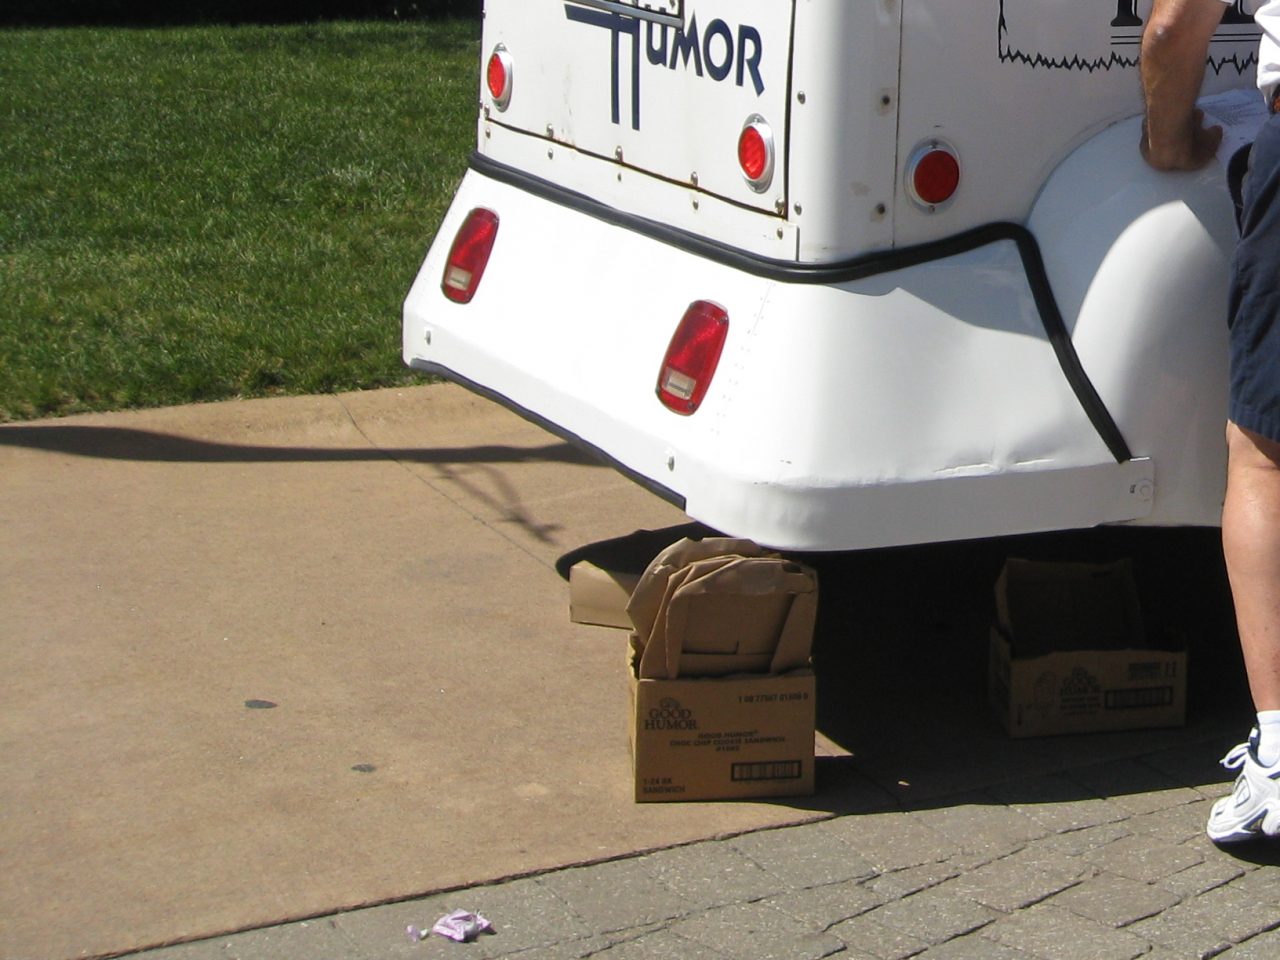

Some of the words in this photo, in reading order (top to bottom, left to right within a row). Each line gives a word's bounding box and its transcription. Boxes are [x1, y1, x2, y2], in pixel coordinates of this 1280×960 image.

[649, 708, 692, 720] GOOD
[644, 719, 697, 730] HUMOR
[643, 785, 686, 794] SANDWICH
